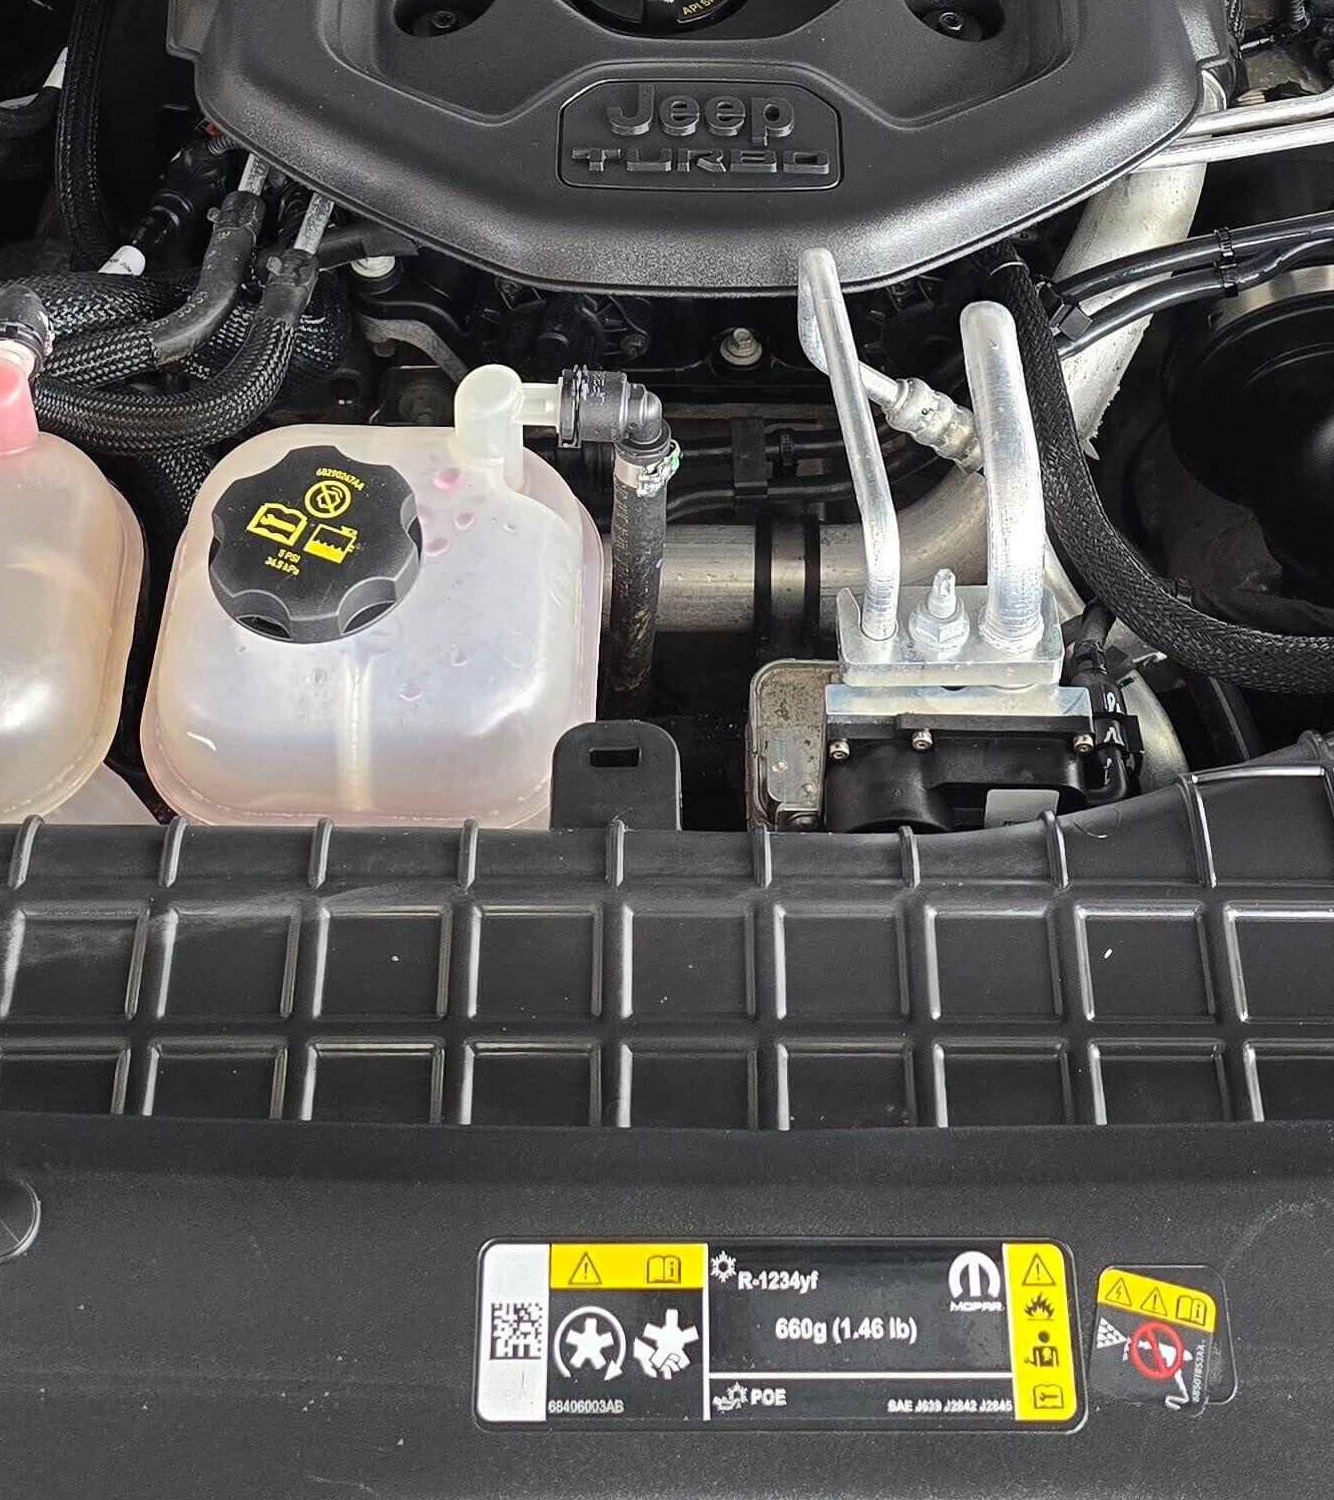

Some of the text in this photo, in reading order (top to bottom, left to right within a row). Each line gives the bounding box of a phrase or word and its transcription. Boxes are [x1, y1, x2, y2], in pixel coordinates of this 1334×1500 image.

[682, 2, 703, 16] API
[605, 83, 796, 147] Jeep
[571, 147, 831, 175] TURBO
[737, 1269, 820, 1295] R-1234yf
[949, 1300, 1004, 1312] MOPAR
[774, 1316, 918, 1345] 660g (1.46 lb)
[547, 1398, 625, 1414] 68406003AB
[750, 1387, 788, 1406] POE
[887, 1398, 1013, 1414] SAE J639 J2842 J2845
